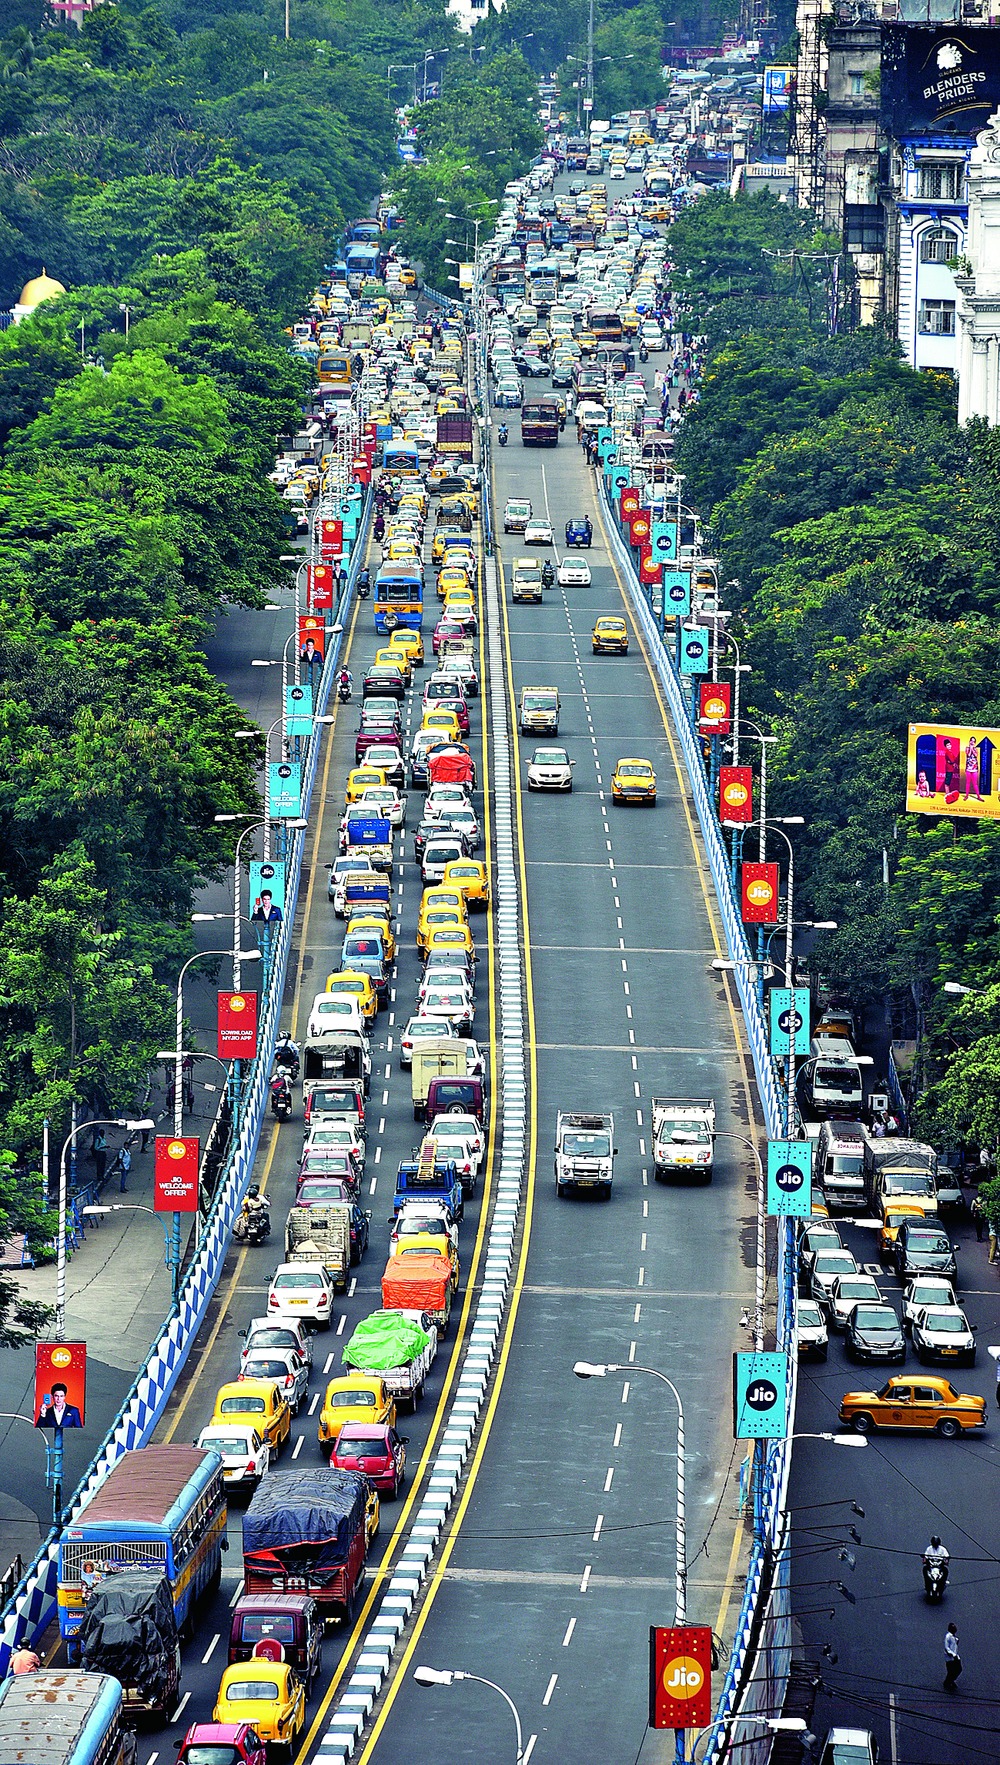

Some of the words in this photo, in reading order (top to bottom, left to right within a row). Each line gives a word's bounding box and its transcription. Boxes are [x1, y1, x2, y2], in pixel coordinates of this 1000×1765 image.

[923, 72, 986, 99] BLENDERS
[938, 84, 975, 102] PRIDE
[671, 589, 684, 597] Jio
[687, 645, 702, 654] Jio
[707, 703, 725, 714] Jio
[279, 767, 290, 775] Jio
[727, 788, 745, 800] Jio
[750, 886, 771, 898] Jio
[231, 999, 244, 1007] Jio
[171, 1145, 183, 1154] Jio
[779, 1171, 801, 1184] Jio
[53, 1351, 70, 1362] Jio
[749, 1387, 775, 1402] Jio
[668, 1666, 700, 1687] Jio
